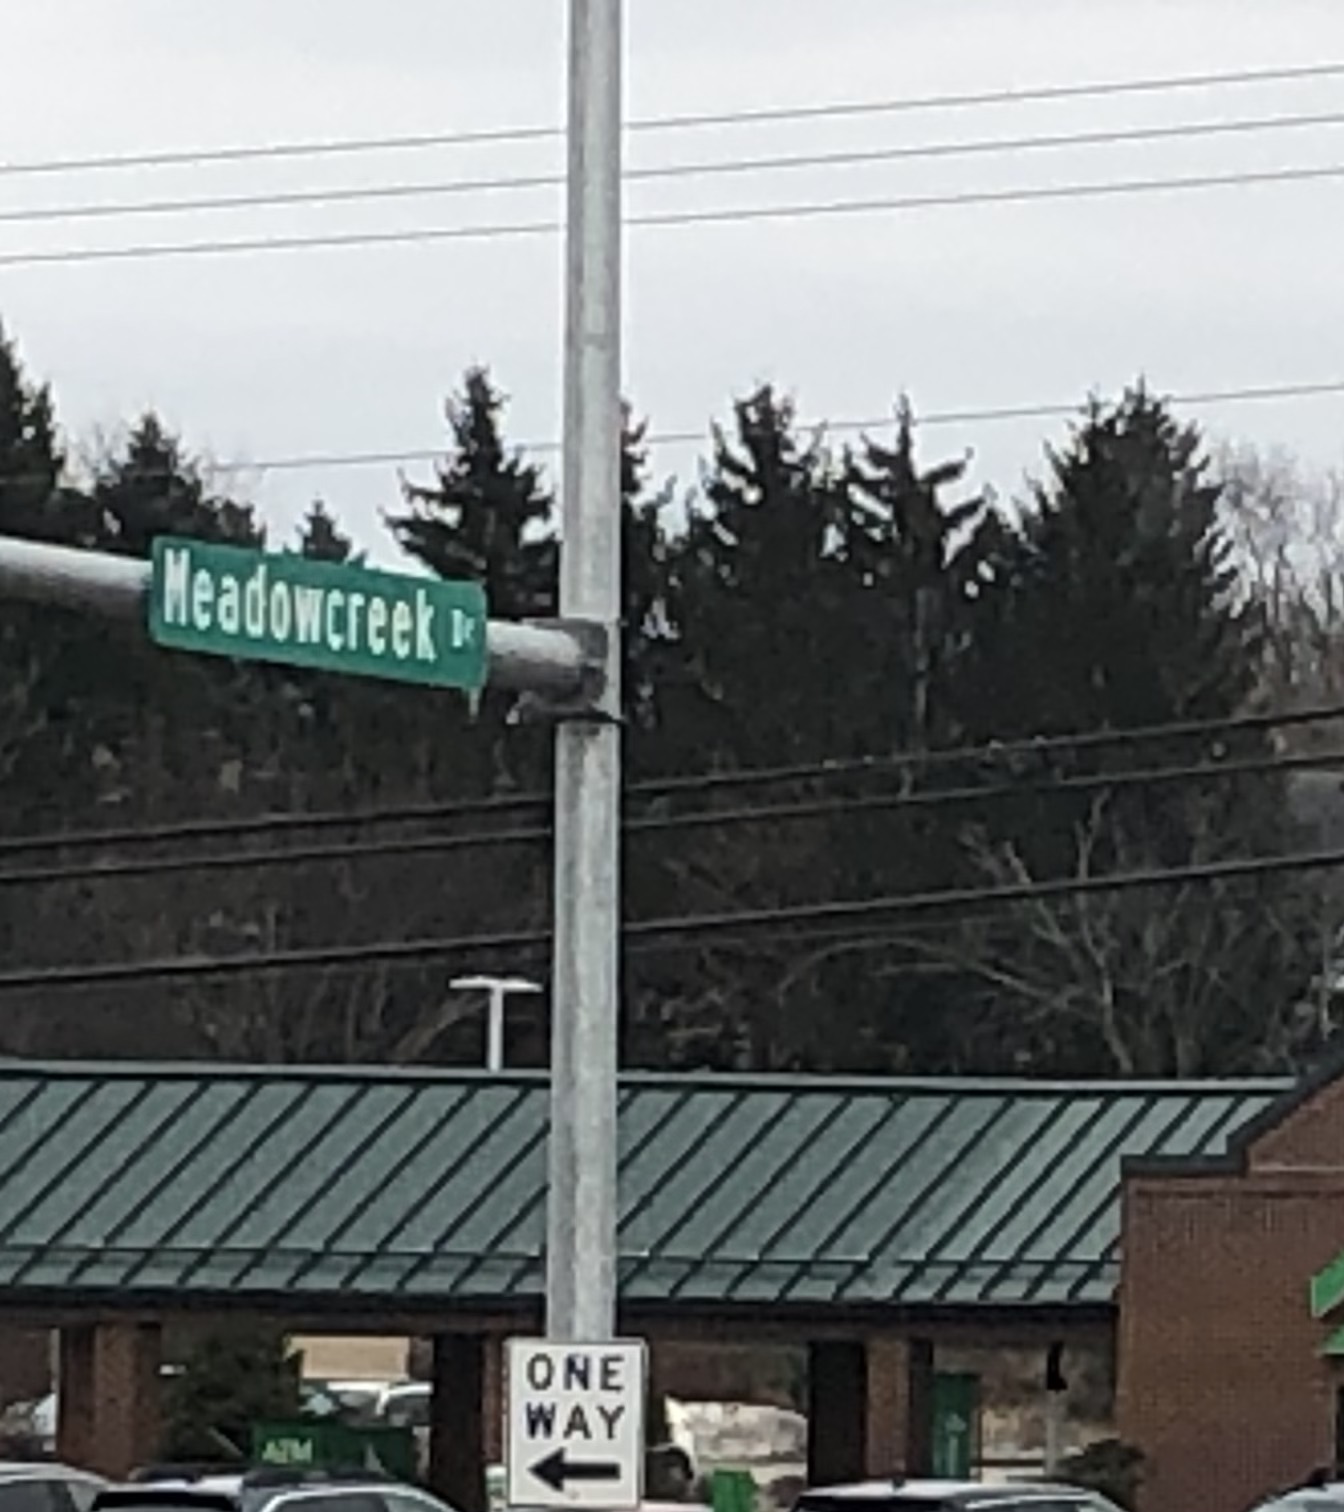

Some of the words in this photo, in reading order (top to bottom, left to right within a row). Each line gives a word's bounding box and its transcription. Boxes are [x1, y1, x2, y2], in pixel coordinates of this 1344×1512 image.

[163, 547, 438, 662] Meadowcreek
[526, 1352, 625, 1391] ONE
[525, 1402, 625, 1440] WAY
